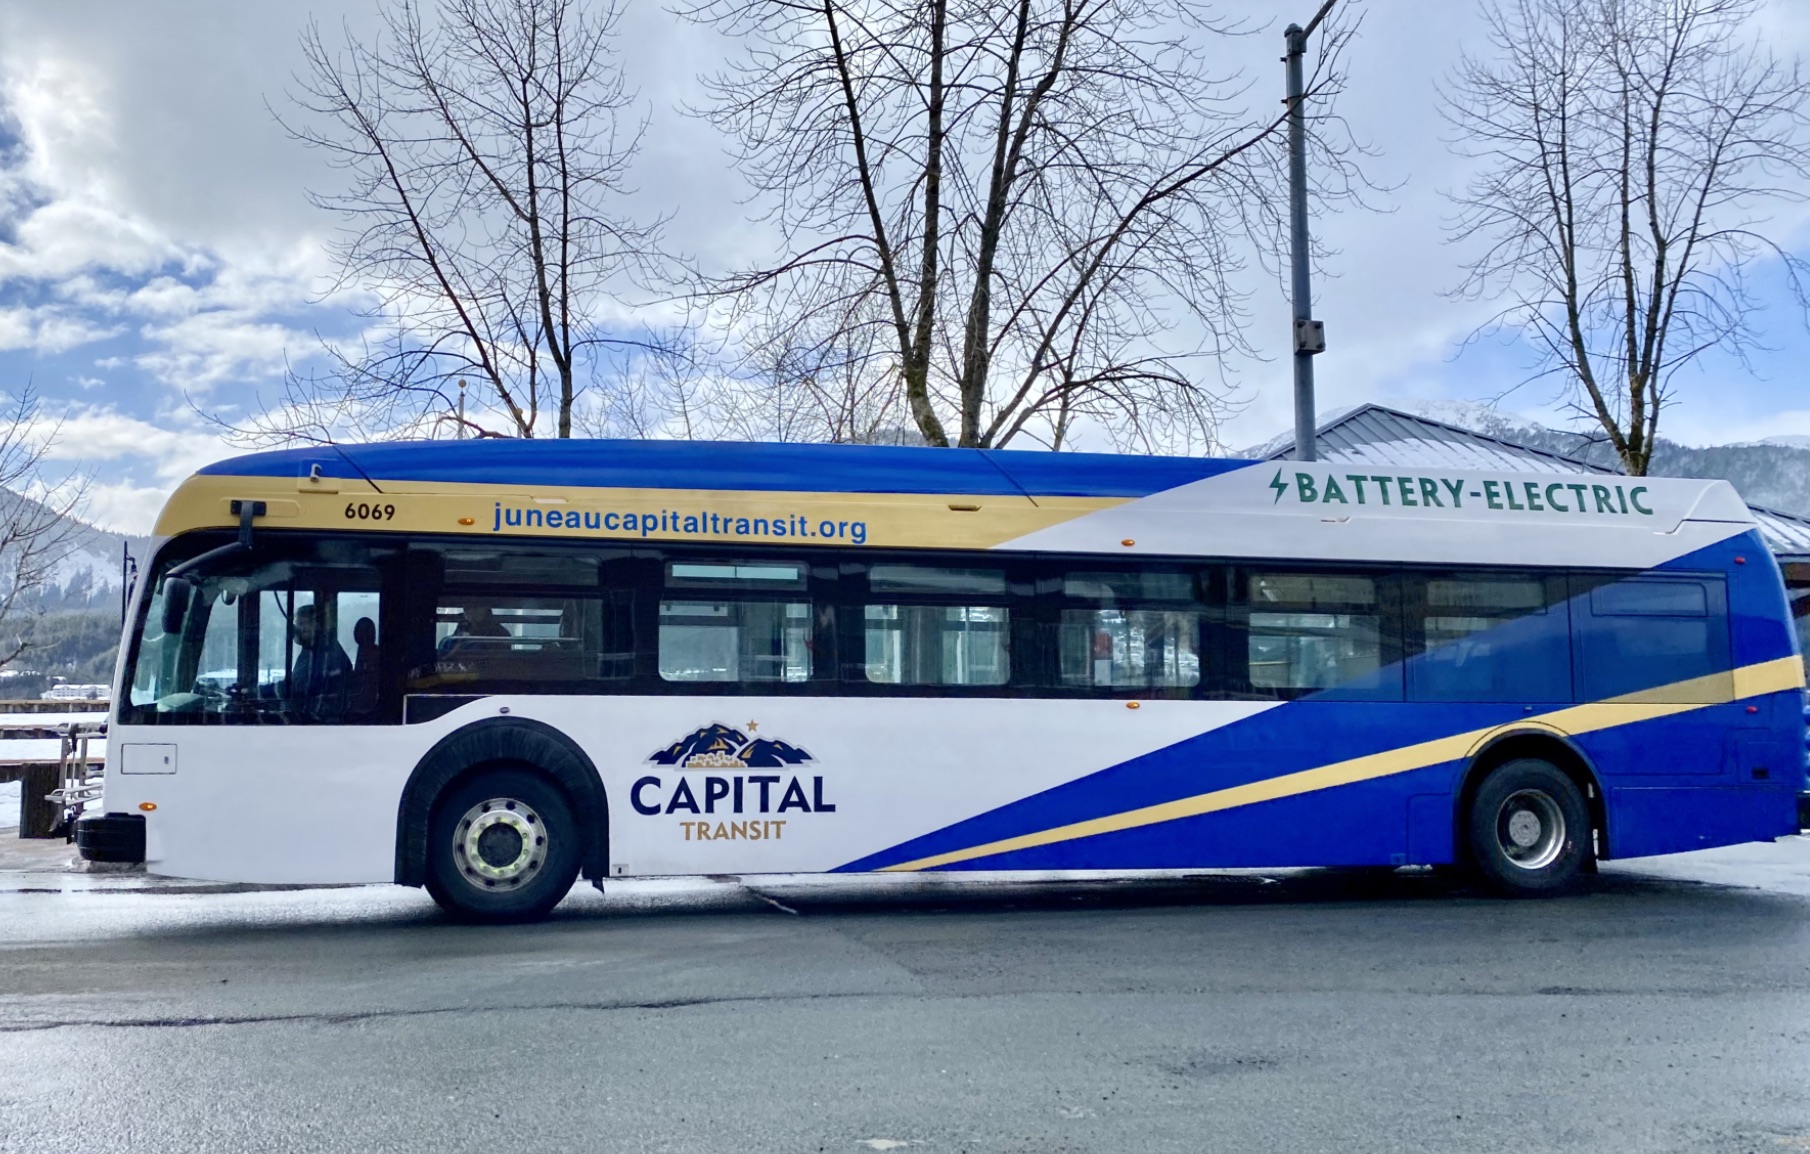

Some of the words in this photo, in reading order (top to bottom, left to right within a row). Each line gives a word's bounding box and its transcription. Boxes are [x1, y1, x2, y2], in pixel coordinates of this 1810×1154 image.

[344, 503, 396, 521] 6069
[1295, 472, 1654, 515] BATTERY-ELECTRIC
[493, 502, 867, 544] juneaucapitaltransit.org
[630, 775, 836, 815] CAPITAL
[680, 820, 786, 841] TRANSIT
